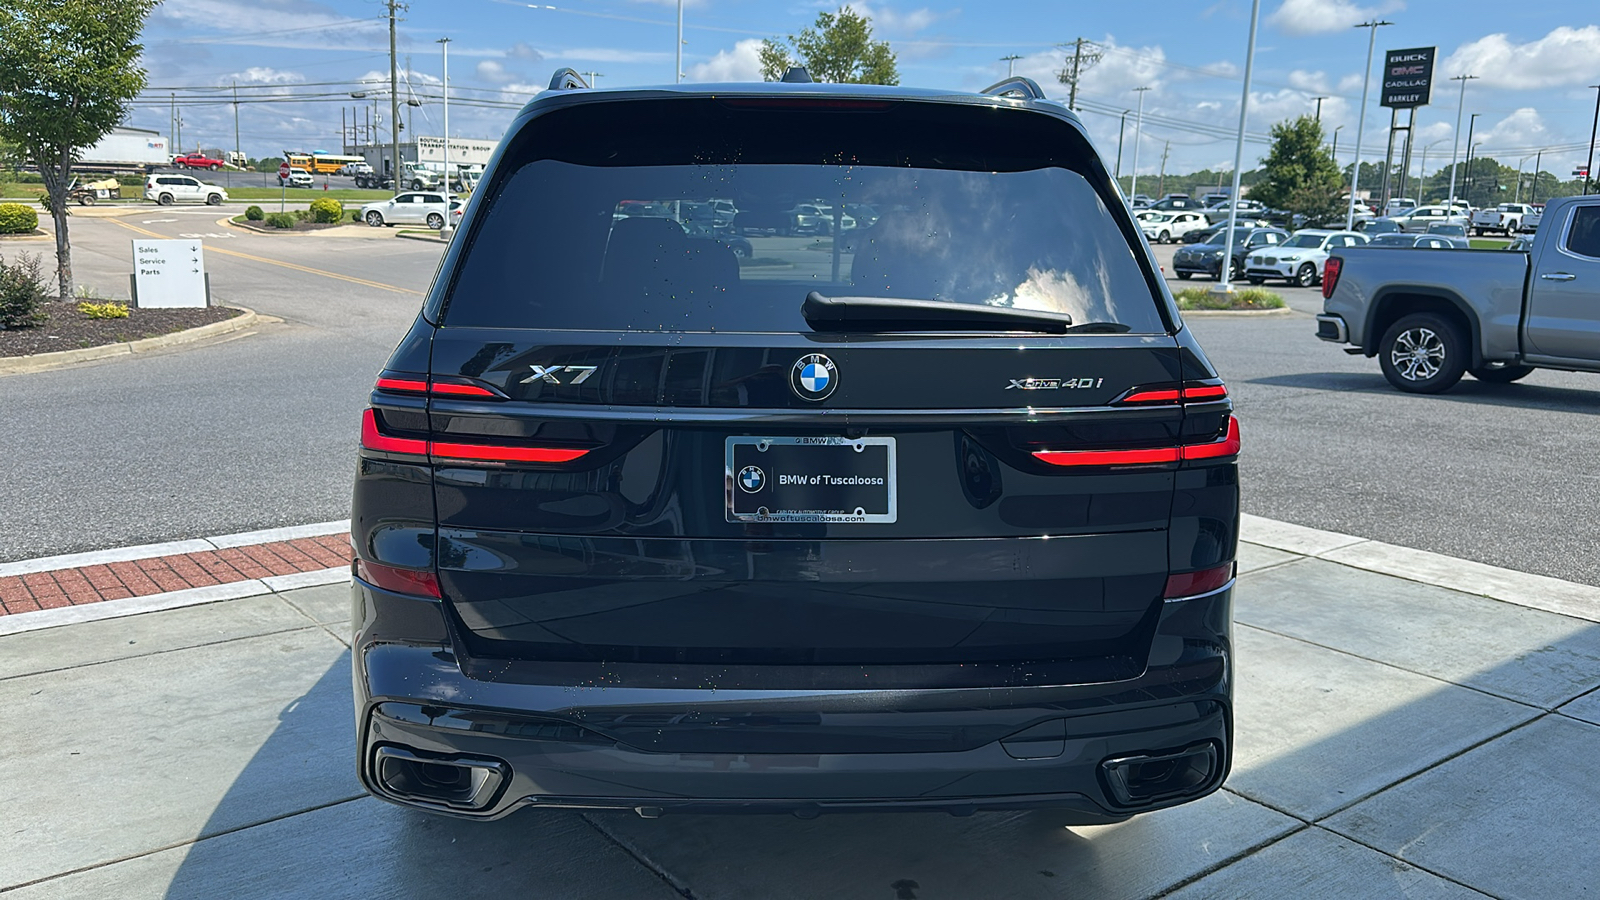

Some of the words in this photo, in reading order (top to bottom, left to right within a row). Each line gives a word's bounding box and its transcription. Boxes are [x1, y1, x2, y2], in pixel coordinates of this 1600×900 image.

[1390, 53, 1427, 63] BUICK
[1391, 65, 1424, 76] GMC
[1385, 79, 1427, 88] CADILLAC
[1388, 94, 1420, 103] BARKLEY
[796, 355, 834, 371] BMW
[519, 364, 598, 385] X7
[779, 475, 807, 485] BMW
[809, 475, 821, 485] of
[823, 475, 884, 485] Tuscaloosa
[757, 514, 865, 522] bmwoftuscaloosa.com
